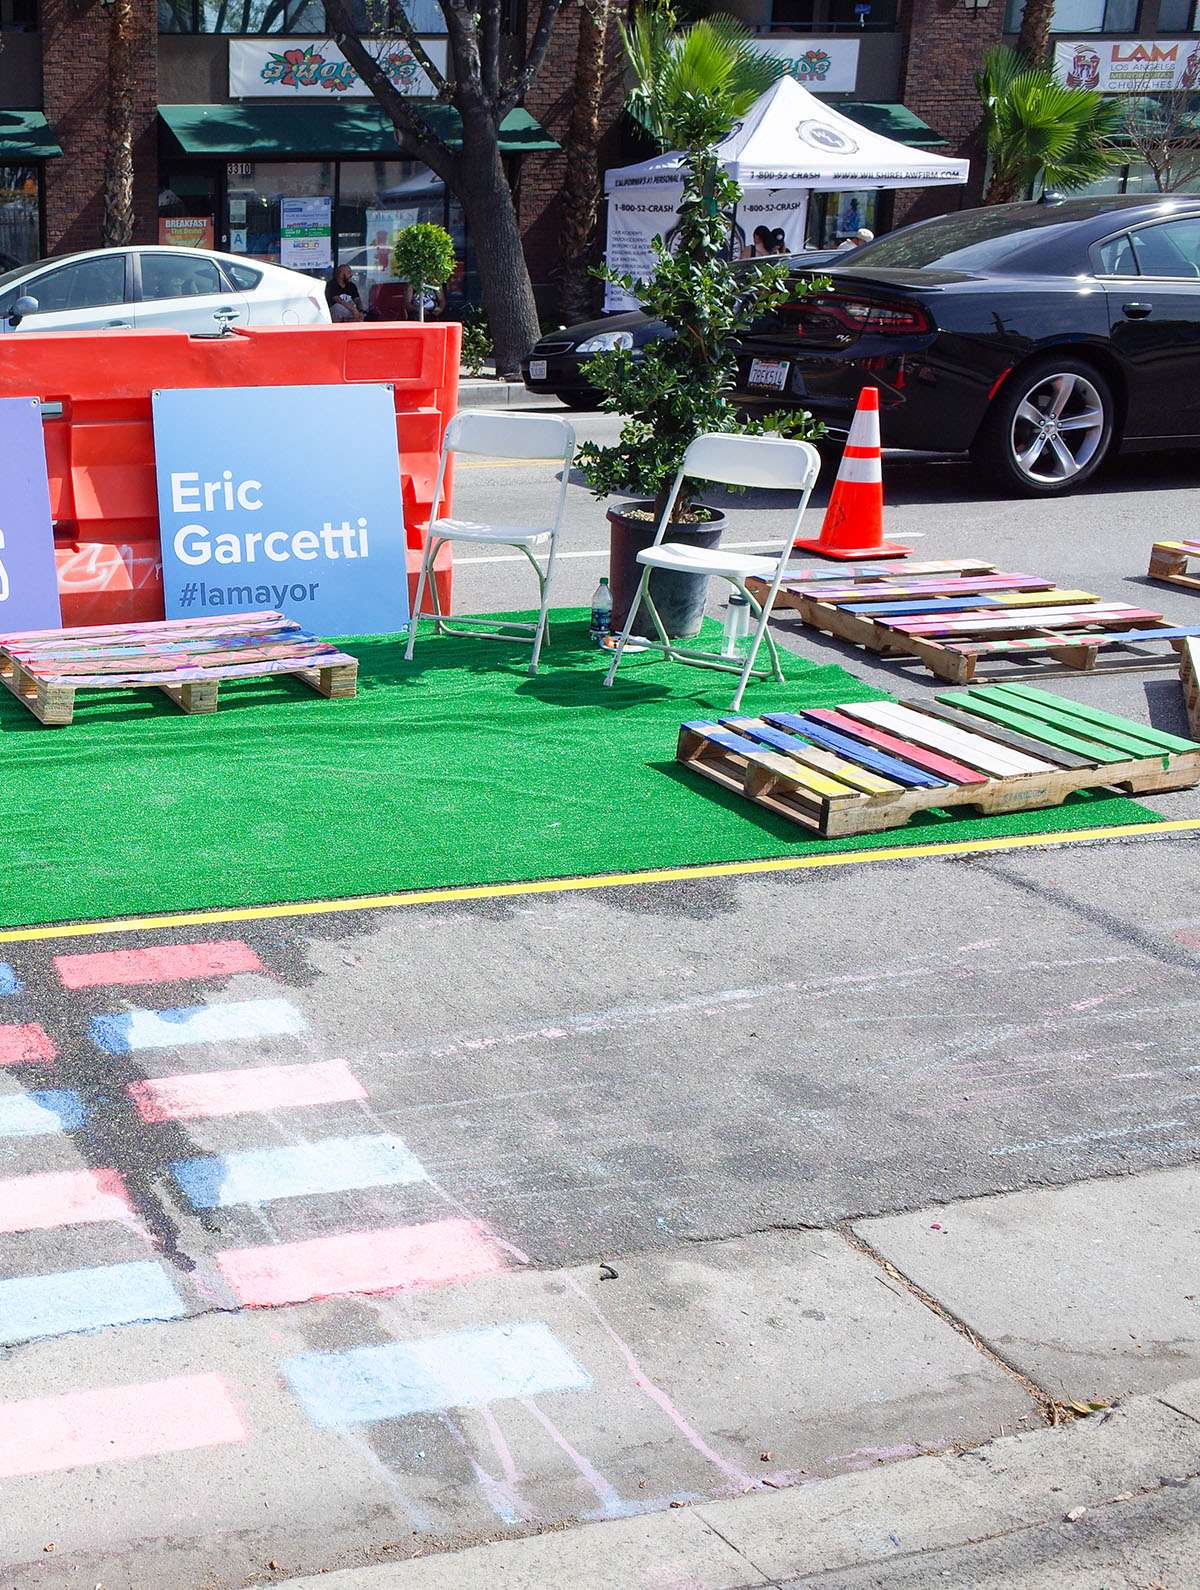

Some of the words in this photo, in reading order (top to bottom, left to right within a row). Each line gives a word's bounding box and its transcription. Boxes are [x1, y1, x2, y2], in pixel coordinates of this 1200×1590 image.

[1111, 44, 1179, 62] LAM
[1110, 63, 1129, 71] LOS
[1133, 63, 1176, 71] ANGELES
[1108, 80, 1173, 89] CHURCHES
[227, 162, 251, 175] 3310
[751, 171, 820, 180] 1-800-52-CRASH
[833, 171, 960, 180] WWW.WILSHIRELAWFIRM.COM
[614, 203, 674, 213] 1-800-52-CRASH
[743, 201, 801, 212] 1-800-52-CRASH
[165, 219, 208, 228] BREAKFAST
[234, 233, 244, 245] A
[171, 470, 264, 513] Eric
[173, 517, 369, 566] Garcetti
[179, 581, 320, 609] #lamayor
